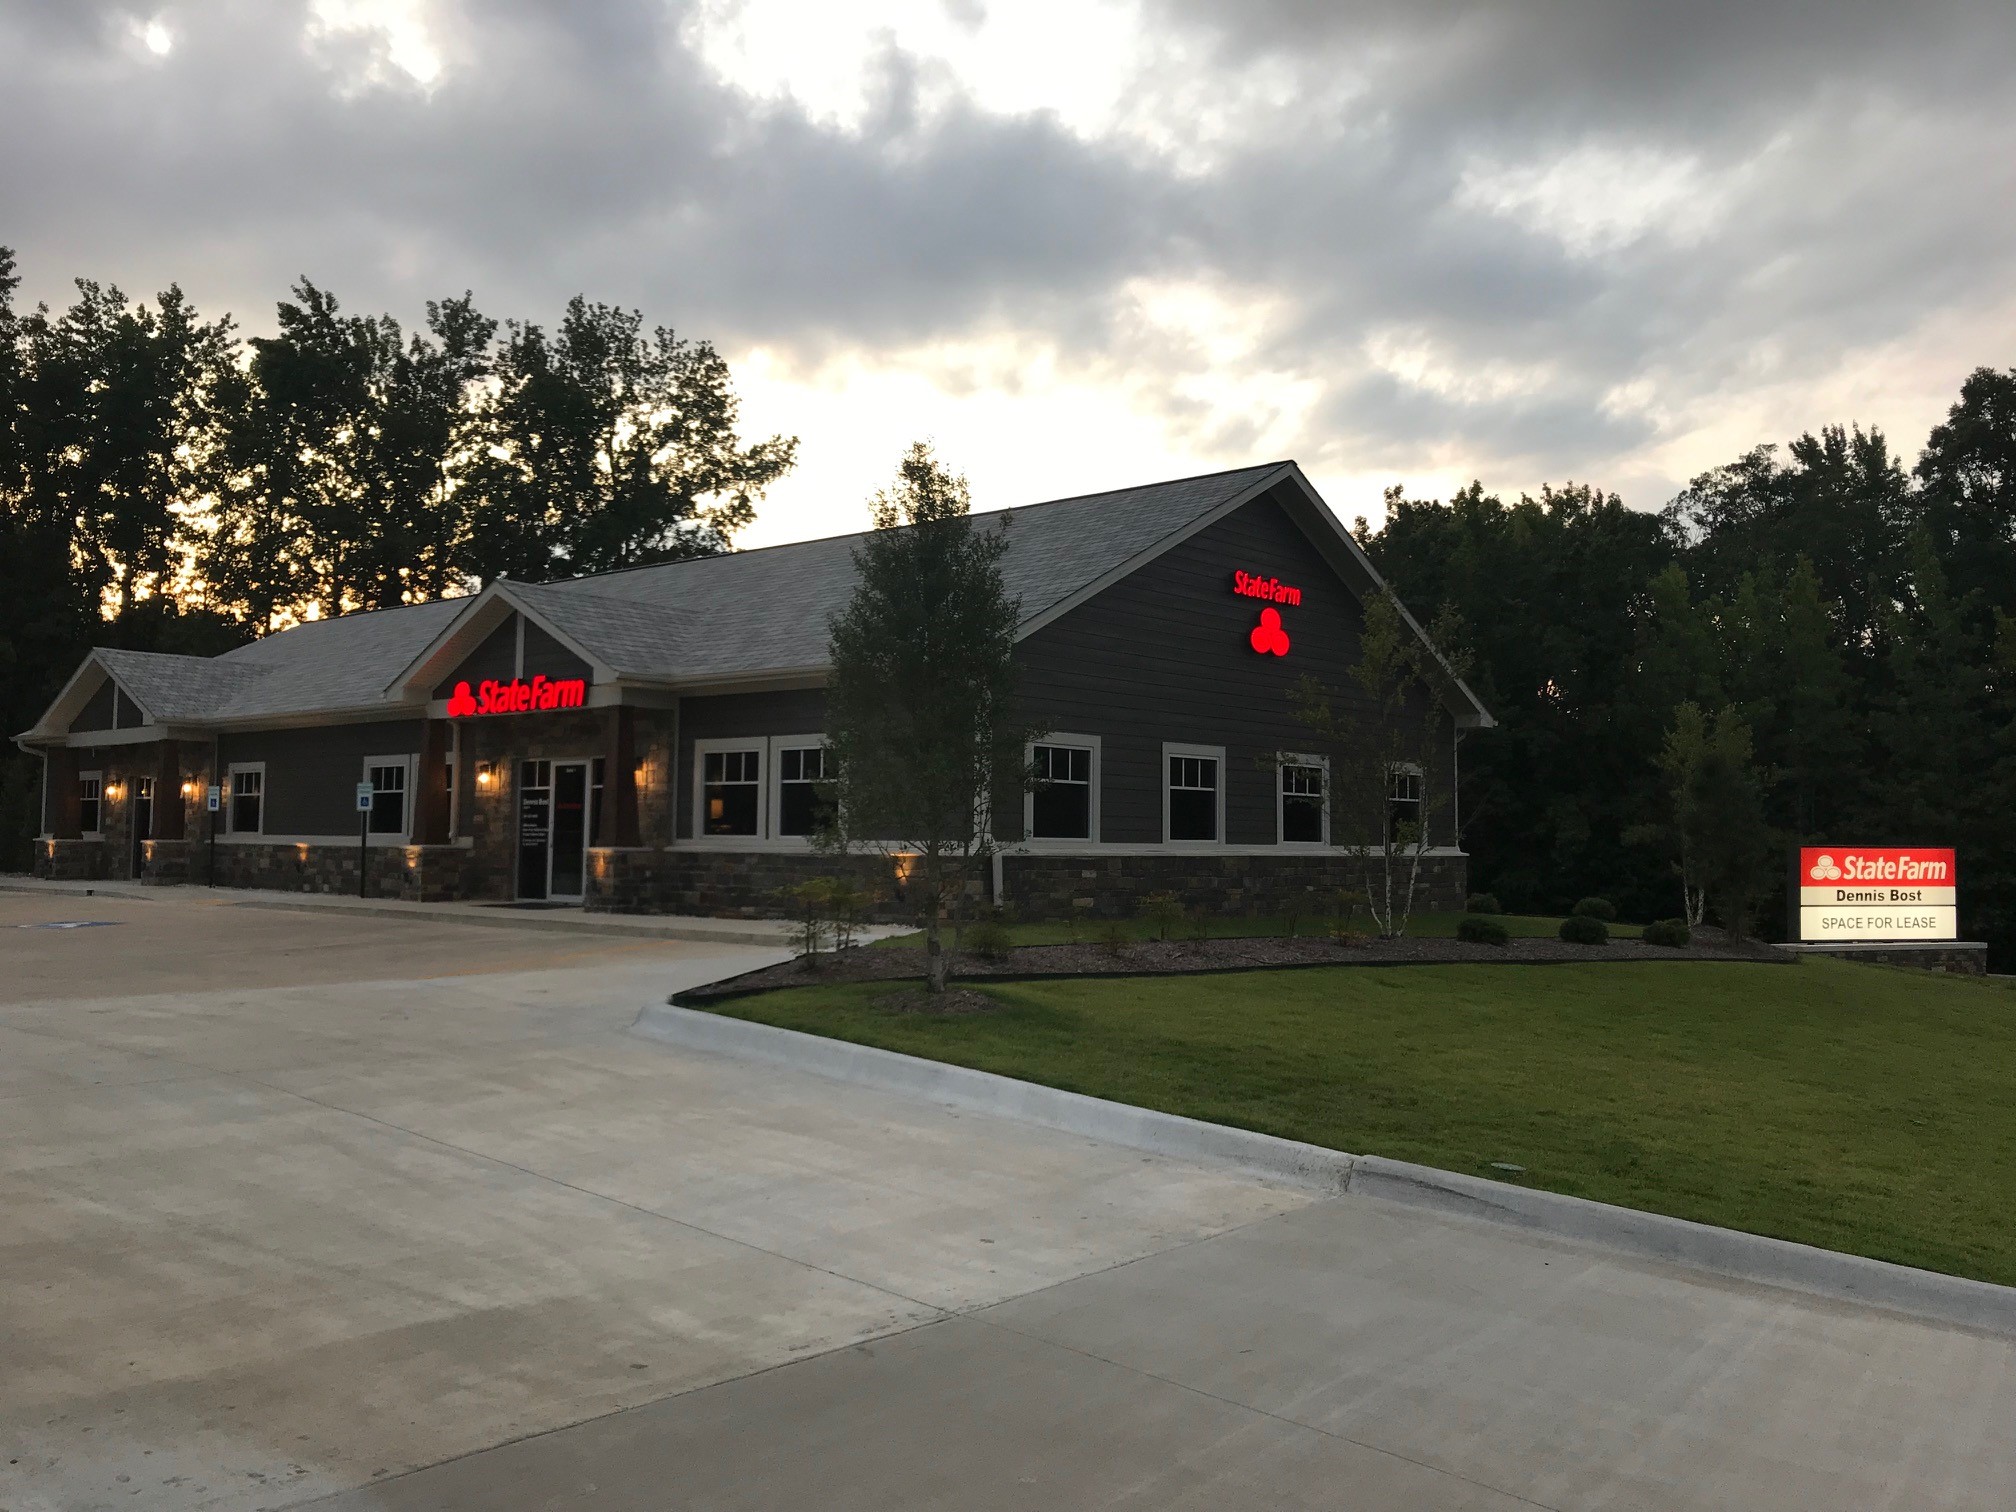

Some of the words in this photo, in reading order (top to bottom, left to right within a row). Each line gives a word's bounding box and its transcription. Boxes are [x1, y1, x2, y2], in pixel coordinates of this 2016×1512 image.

[1836, 889, 1885, 902] Dennis
[1890, 889, 1922, 902] Bost
[1822, 917, 1863, 929] SPACE
[1867, 917, 1893, 929] FOR
[1896, 917, 1937, 929] LEASE
